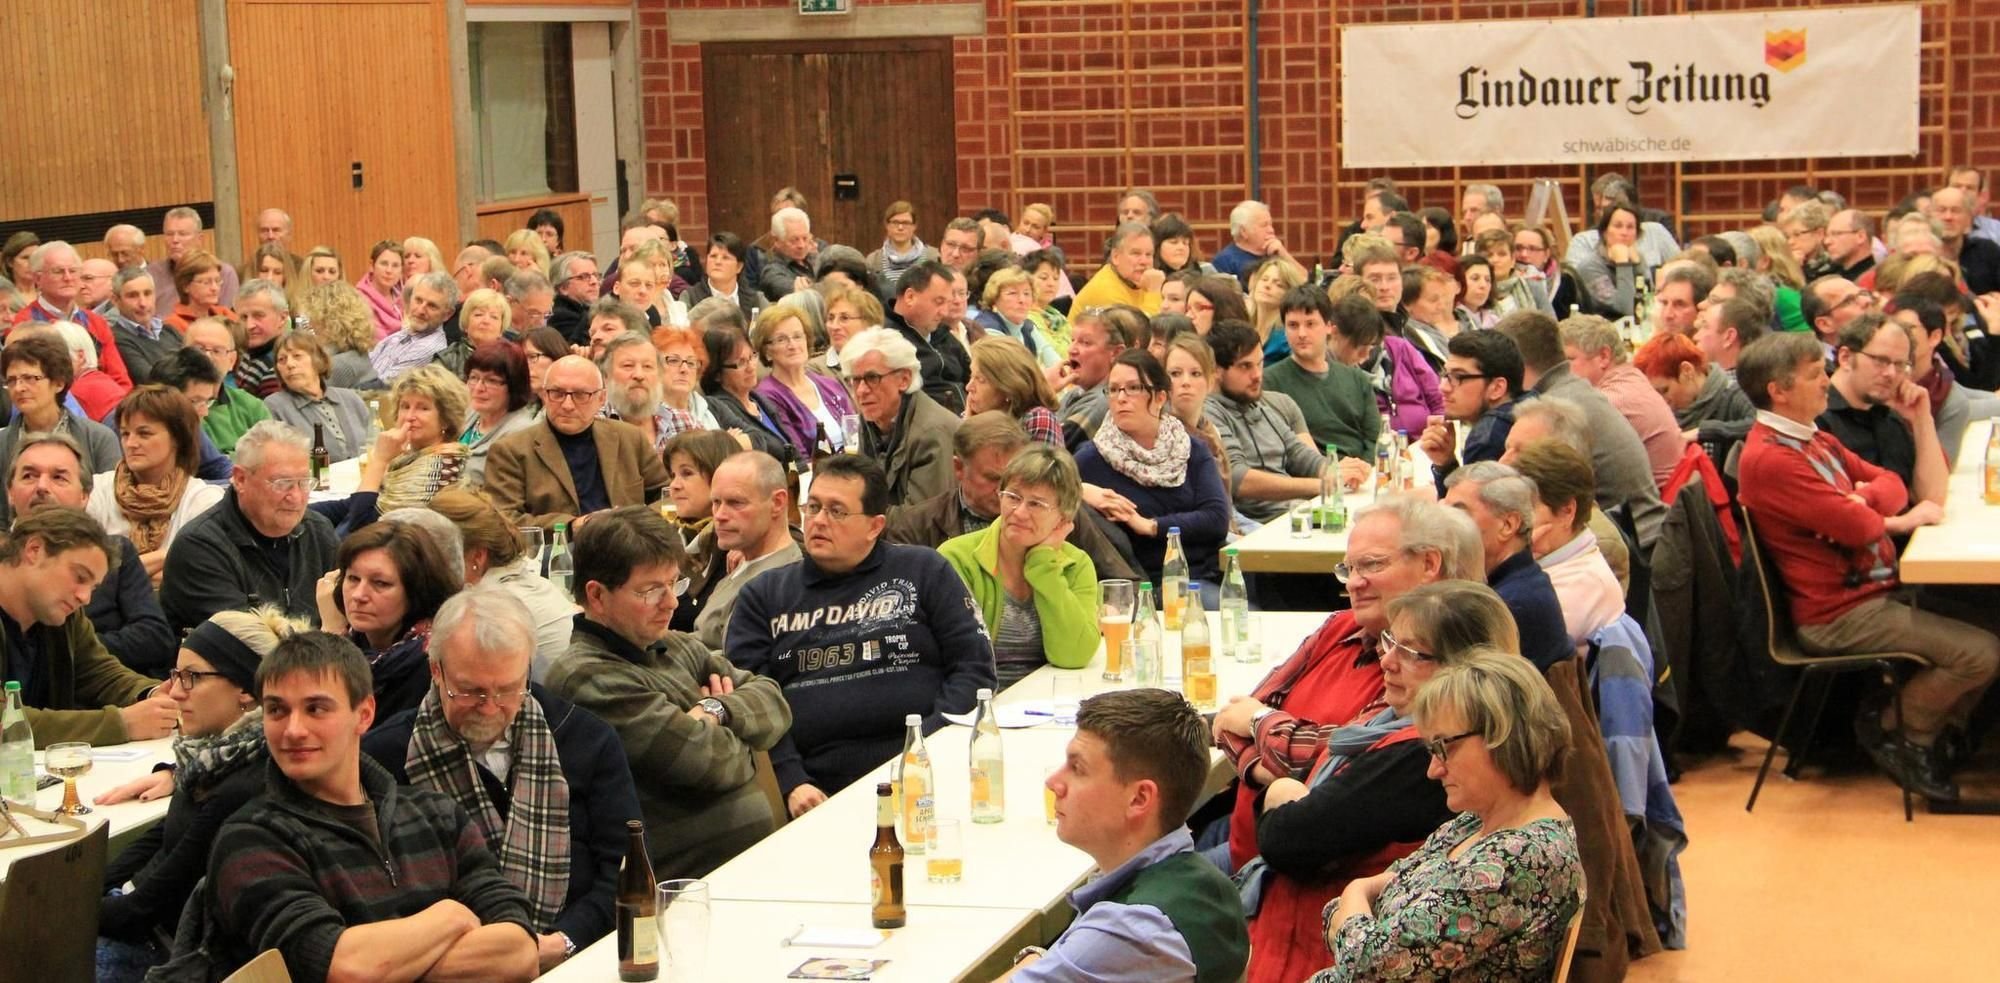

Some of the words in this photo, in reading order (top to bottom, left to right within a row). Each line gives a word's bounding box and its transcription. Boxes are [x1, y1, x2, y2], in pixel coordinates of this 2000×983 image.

[1454, 66, 1621, 119] Lindauer
[1625, 61, 1771, 115] Zeitung
[1563, 137, 1692, 153] schwäbische.de
[825, 599, 894, 625] DAVID
[797, 643, 855, 672] 1963
